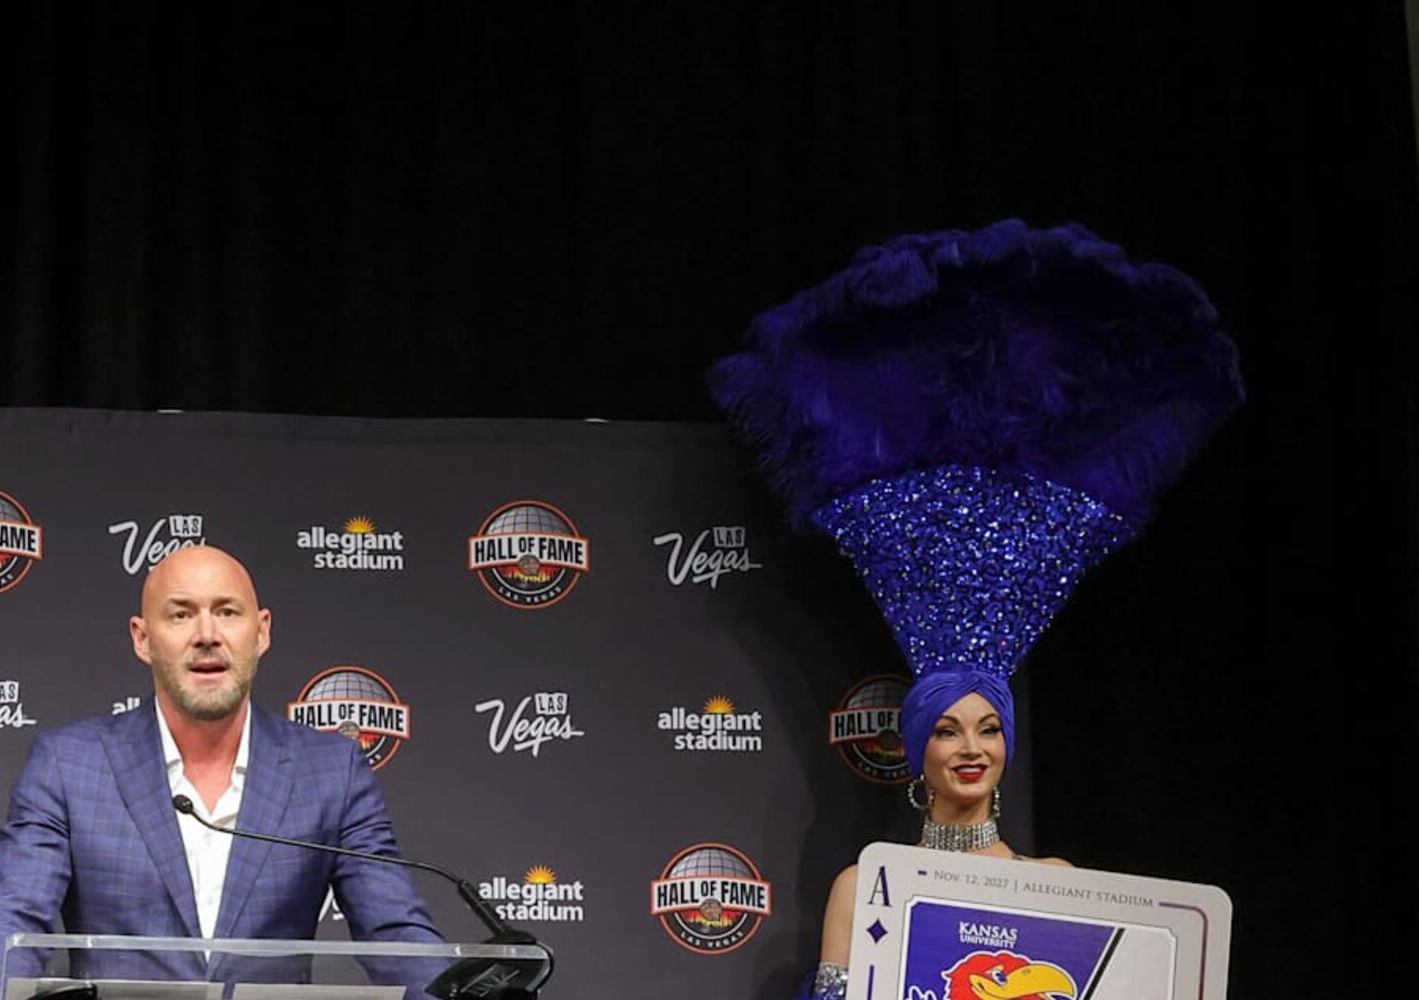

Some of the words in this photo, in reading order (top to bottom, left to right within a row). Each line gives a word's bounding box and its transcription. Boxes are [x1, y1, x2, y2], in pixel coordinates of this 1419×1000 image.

[170, 516, 202, 536] LAS
[297, 526, 403, 554] allegiant
[714, 528, 745, 547] LAS
[314, 550, 403, 571] stadium
[475, 537, 517, 563] HALL
[518, 537, 535, 553] OF
[538, 538, 583, 565] FAME
[654, 530, 763, 588] Vegas
[295, 703, 337, 728] HALL
[338, 703, 355, 719] OF
[358, 704, 402, 732] FAME
[535, 694, 567, 714] LAS
[475, 696, 584, 757] Vegas
[657, 707, 762, 735] allegiant
[835, 712, 876, 738] HALL
[674, 731, 762, 751] stadium
[479, 877, 583, 905] allegiant
[657, 881, 699, 908] HALL
[700, 881, 717, 897] OF
[721, 881, 764, 909] FAME
[867, 865, 892, 907] A
[984, 876, 1009, 889] 2027
[1023, 882, 1092, 900] ALLEGIANT
[1096, 890, 1153, 908] STADIUM
[495, 901, 583, 921] stadium
[959, 920, 1018, 941] KANSAS
[959, 934, 1016, 949] UNIVERSITY
